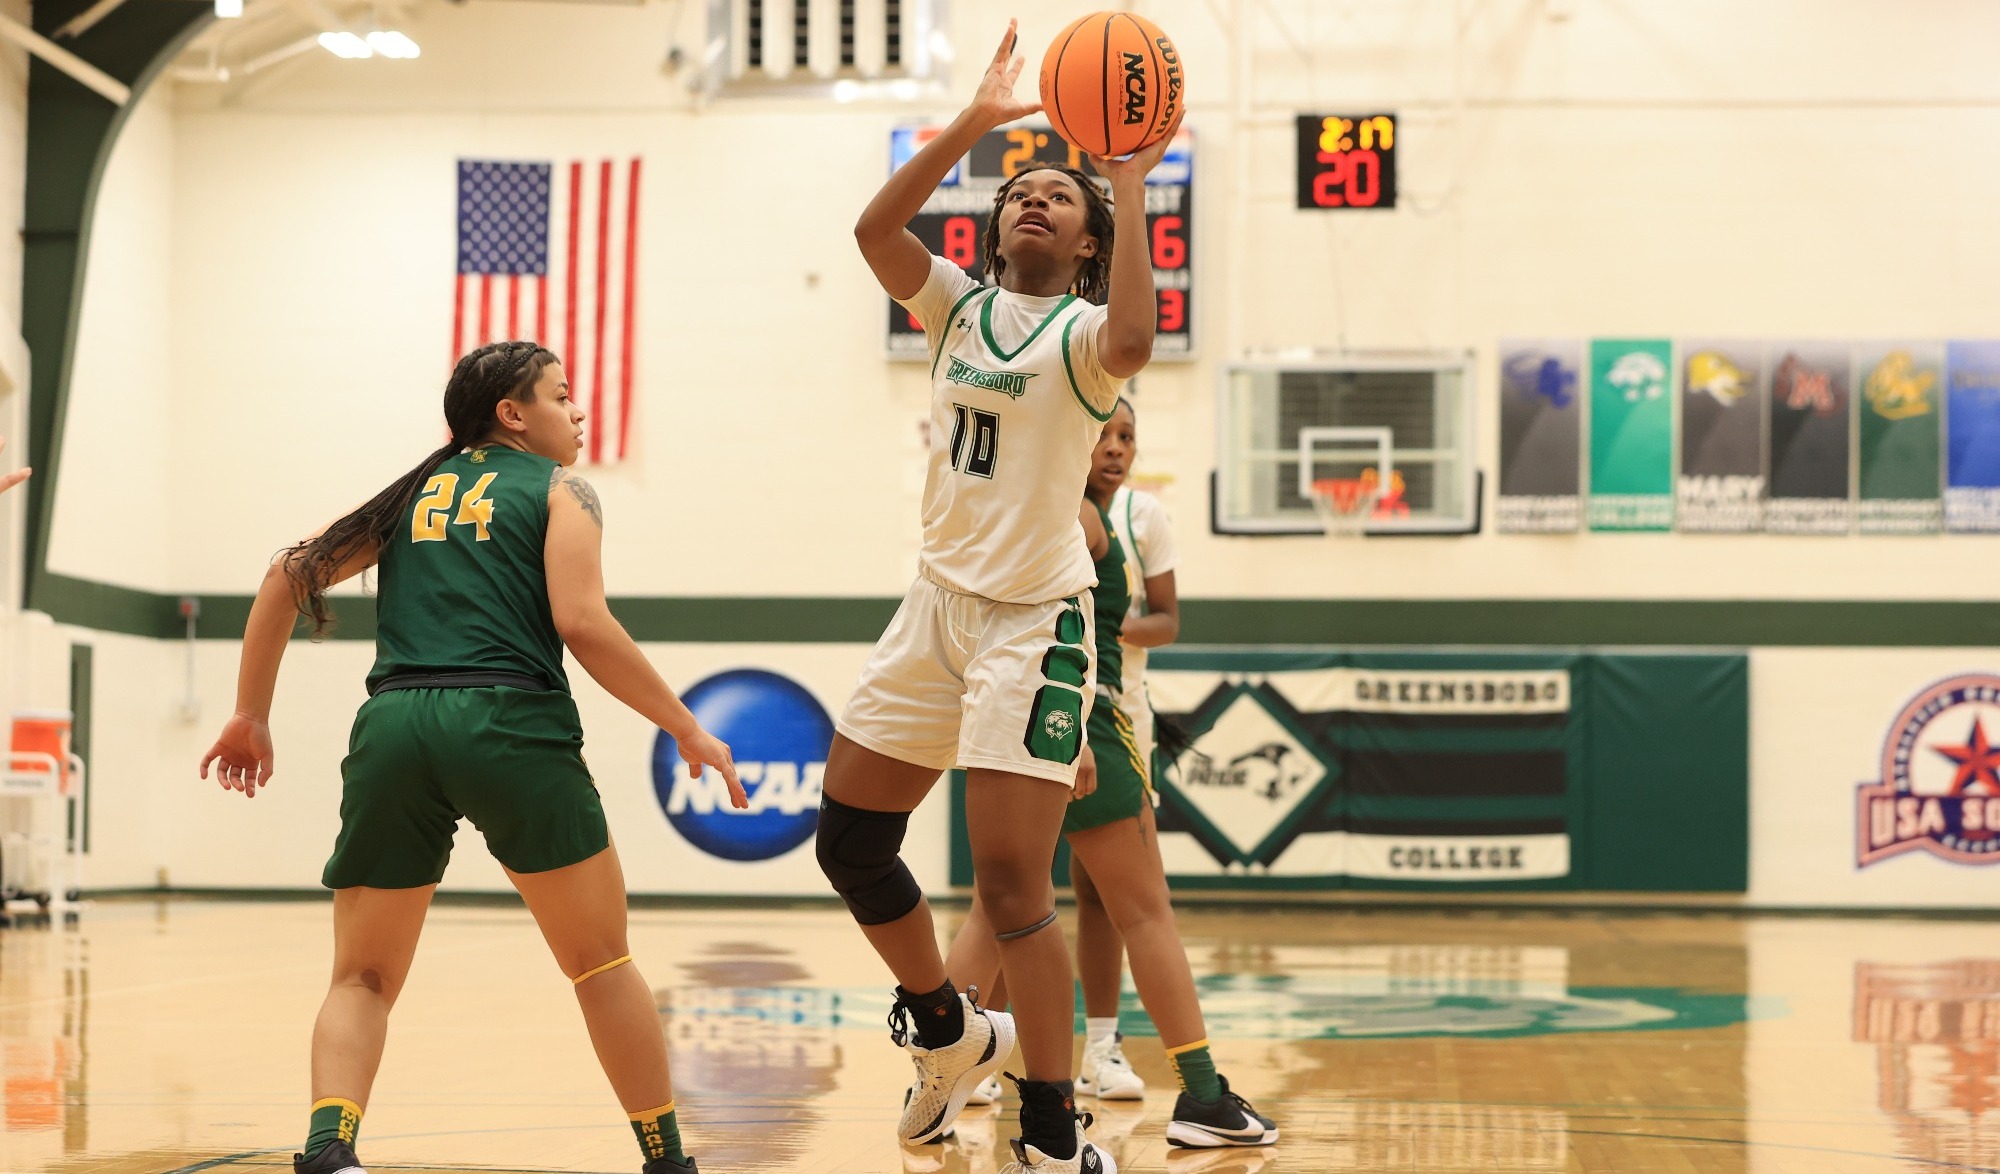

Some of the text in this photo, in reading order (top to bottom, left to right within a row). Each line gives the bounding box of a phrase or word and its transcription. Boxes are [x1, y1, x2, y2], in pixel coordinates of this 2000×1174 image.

[1123, 52, 1146, 126] NCAA
[1155, 35, 1182, 135] Wilson
[1312, 149, 1380, 207] 20
[943, 216, 976, 269] 8
[1152, 216, 1186, 269] 6
[1159, 289, 1185, 331] 3
[946, 356, 1034, 400] GREENSBORO
[950, 402, 1000, 480] 10
[412, 472, 498, 544] 24
[1355, 679, 1559, 703] GREENSBORO
[1870, 798, 1946, 846] USA
[1389, 846, 1524, 870] COLLEGE
